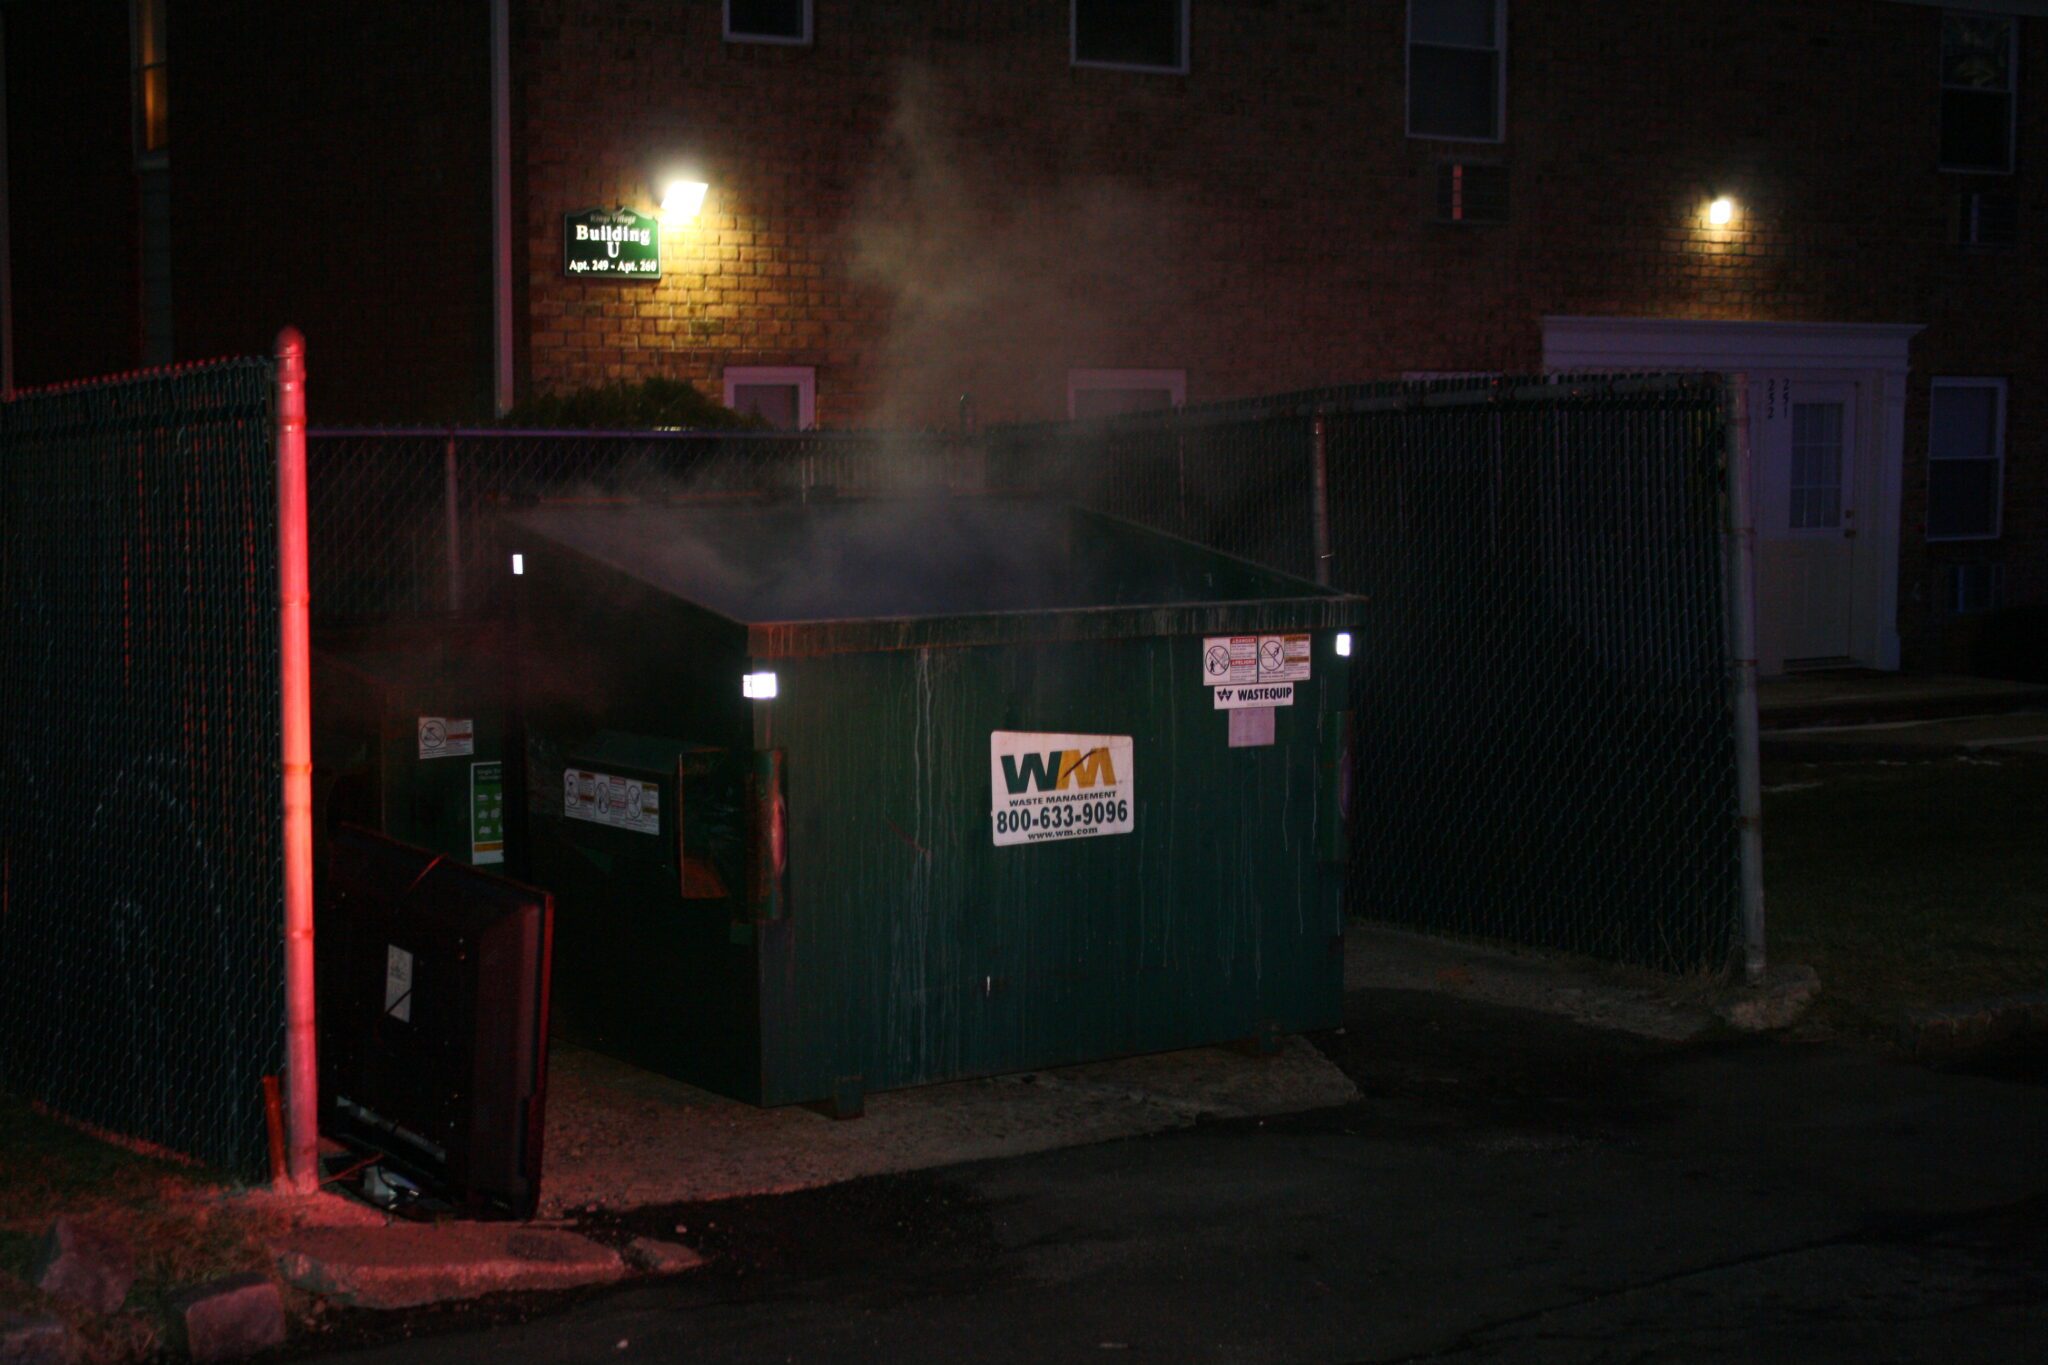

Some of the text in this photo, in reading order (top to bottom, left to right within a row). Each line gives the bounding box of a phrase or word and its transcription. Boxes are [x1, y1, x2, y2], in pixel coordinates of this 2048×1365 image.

[576, 224, 650, 246] Building
[607, 241, 619, 258] U
[569, 260, 590, 273] Apt.
[592, 260, 609, 271] 249
[617, 261, 638, 274] Apt.
[1238, 687, 1292, 701] WASTEQUIP
[1000, 747, 1117, 795] WM
[1009, 791, 1117, 807] WASTE MANAGEMENT
[997, 800, 1128, 834] 800-633-9096
[1027, 827, 1098, 840] www.wm.com
